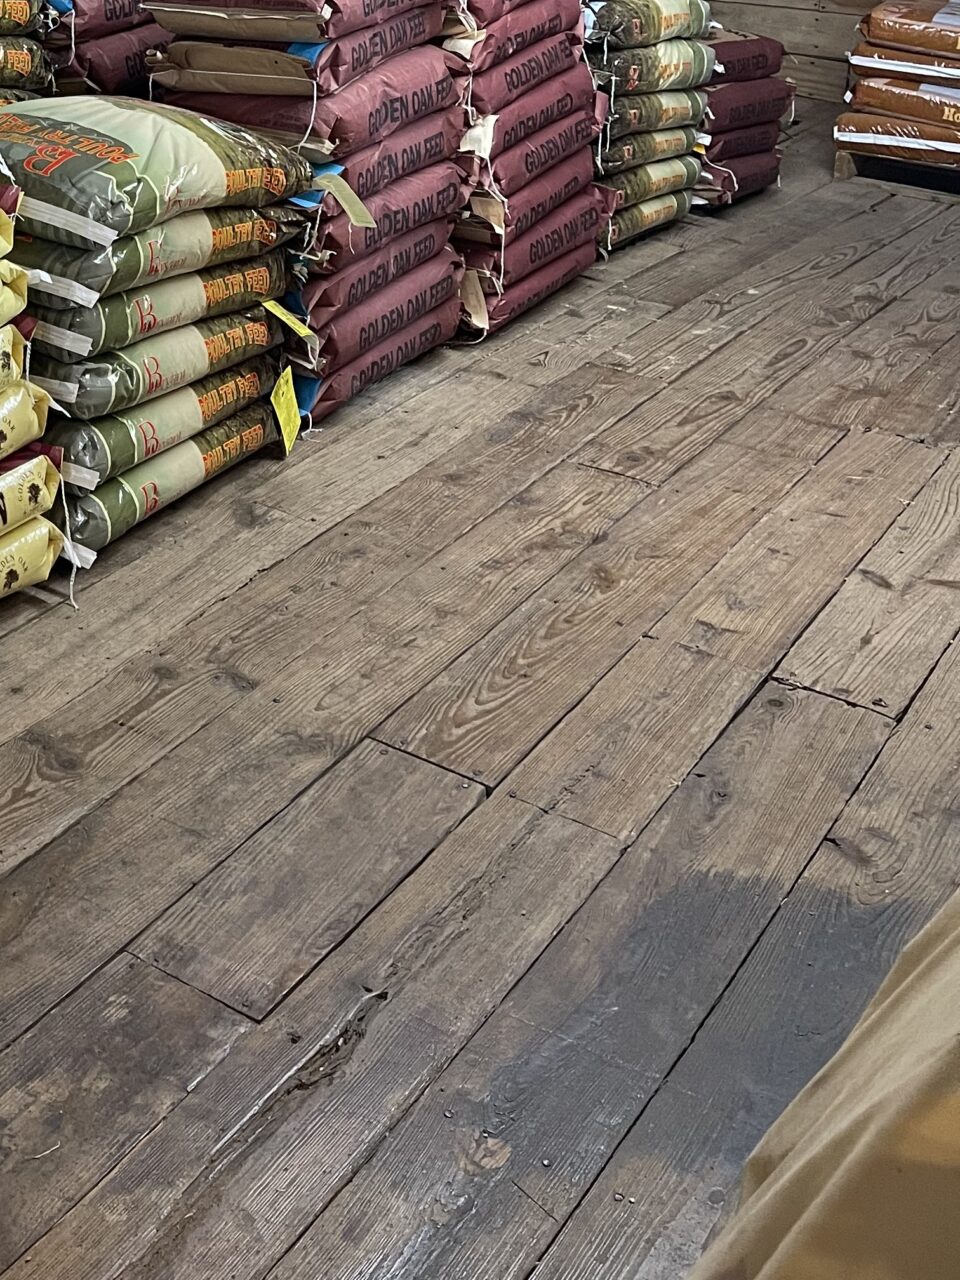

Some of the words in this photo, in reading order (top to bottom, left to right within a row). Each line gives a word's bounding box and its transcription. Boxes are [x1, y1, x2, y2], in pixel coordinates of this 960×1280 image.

[4, 0, 29, 26] FEED
[7, 51, 32, 77] FEED
[412, 84, 434, 116] OAK
[37, 128, 139, 165] POULTRY
[357, 152, 399, 196] GOLDEN
[401, 142, 421, 172] OAK
[424, 131, 445, 159] FEED
[525, 136, 560, 174] GOLDEN
[413, 193, 434, 225] OAK
[212, 222, 253, 251] POULTRY
[529, 225, 564, 264] GOLDEN
[203, 272, 244, 306] POULTRY
[247, 266, 271, 295] FEED
[347, 260, 389, 308] GOLDEN
[391, 246, 411, 279] OAK
[413, 233, 436, 266] FEED
[359, 304, 404, 351] GOLDEN
[407, 287, 427, 321] OAK
[429, 275, 454, 309] FEED
[204, 326, 244, 363] POULTRY
[246, 321, 271, 347] FEED
[395, 334, 416, 369] OAK
[198, 379, 236, 420] POULTRY
[237, 372, 260, 398] FEED
[202, 436, 241, 478] POULTRY
[242, 423, 264, 452] FEED
